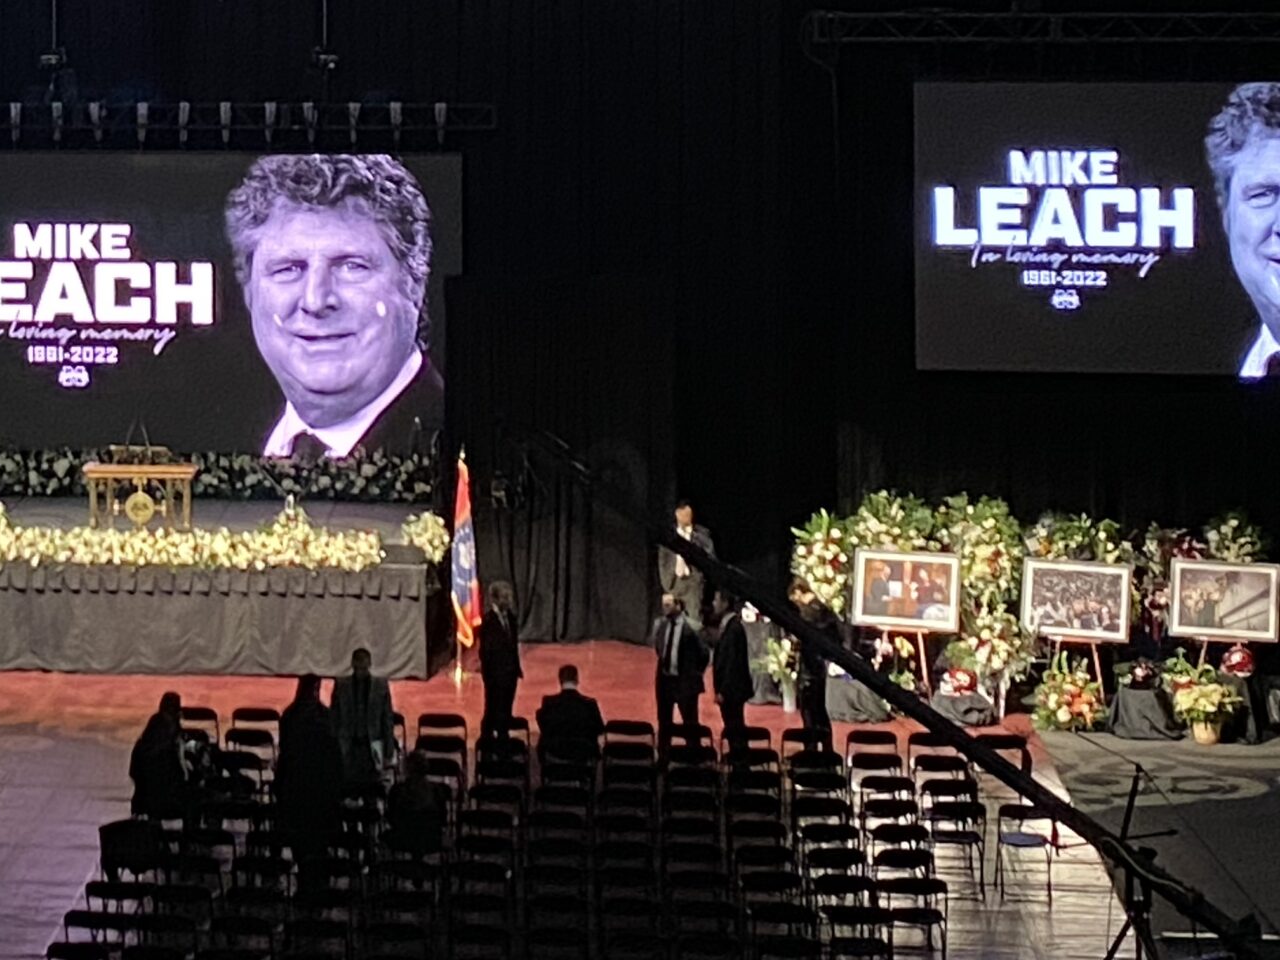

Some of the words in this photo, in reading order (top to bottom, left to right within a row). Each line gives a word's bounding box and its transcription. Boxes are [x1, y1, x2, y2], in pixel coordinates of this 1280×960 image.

[1009, 150, 1119, 185] MIKE
[933, 186, 1195, 248] LEACH
[13, 223, 132, 259] MIKE
[1071, 253, 1161, 279] memory
[79, 327, 176, 355] memory
